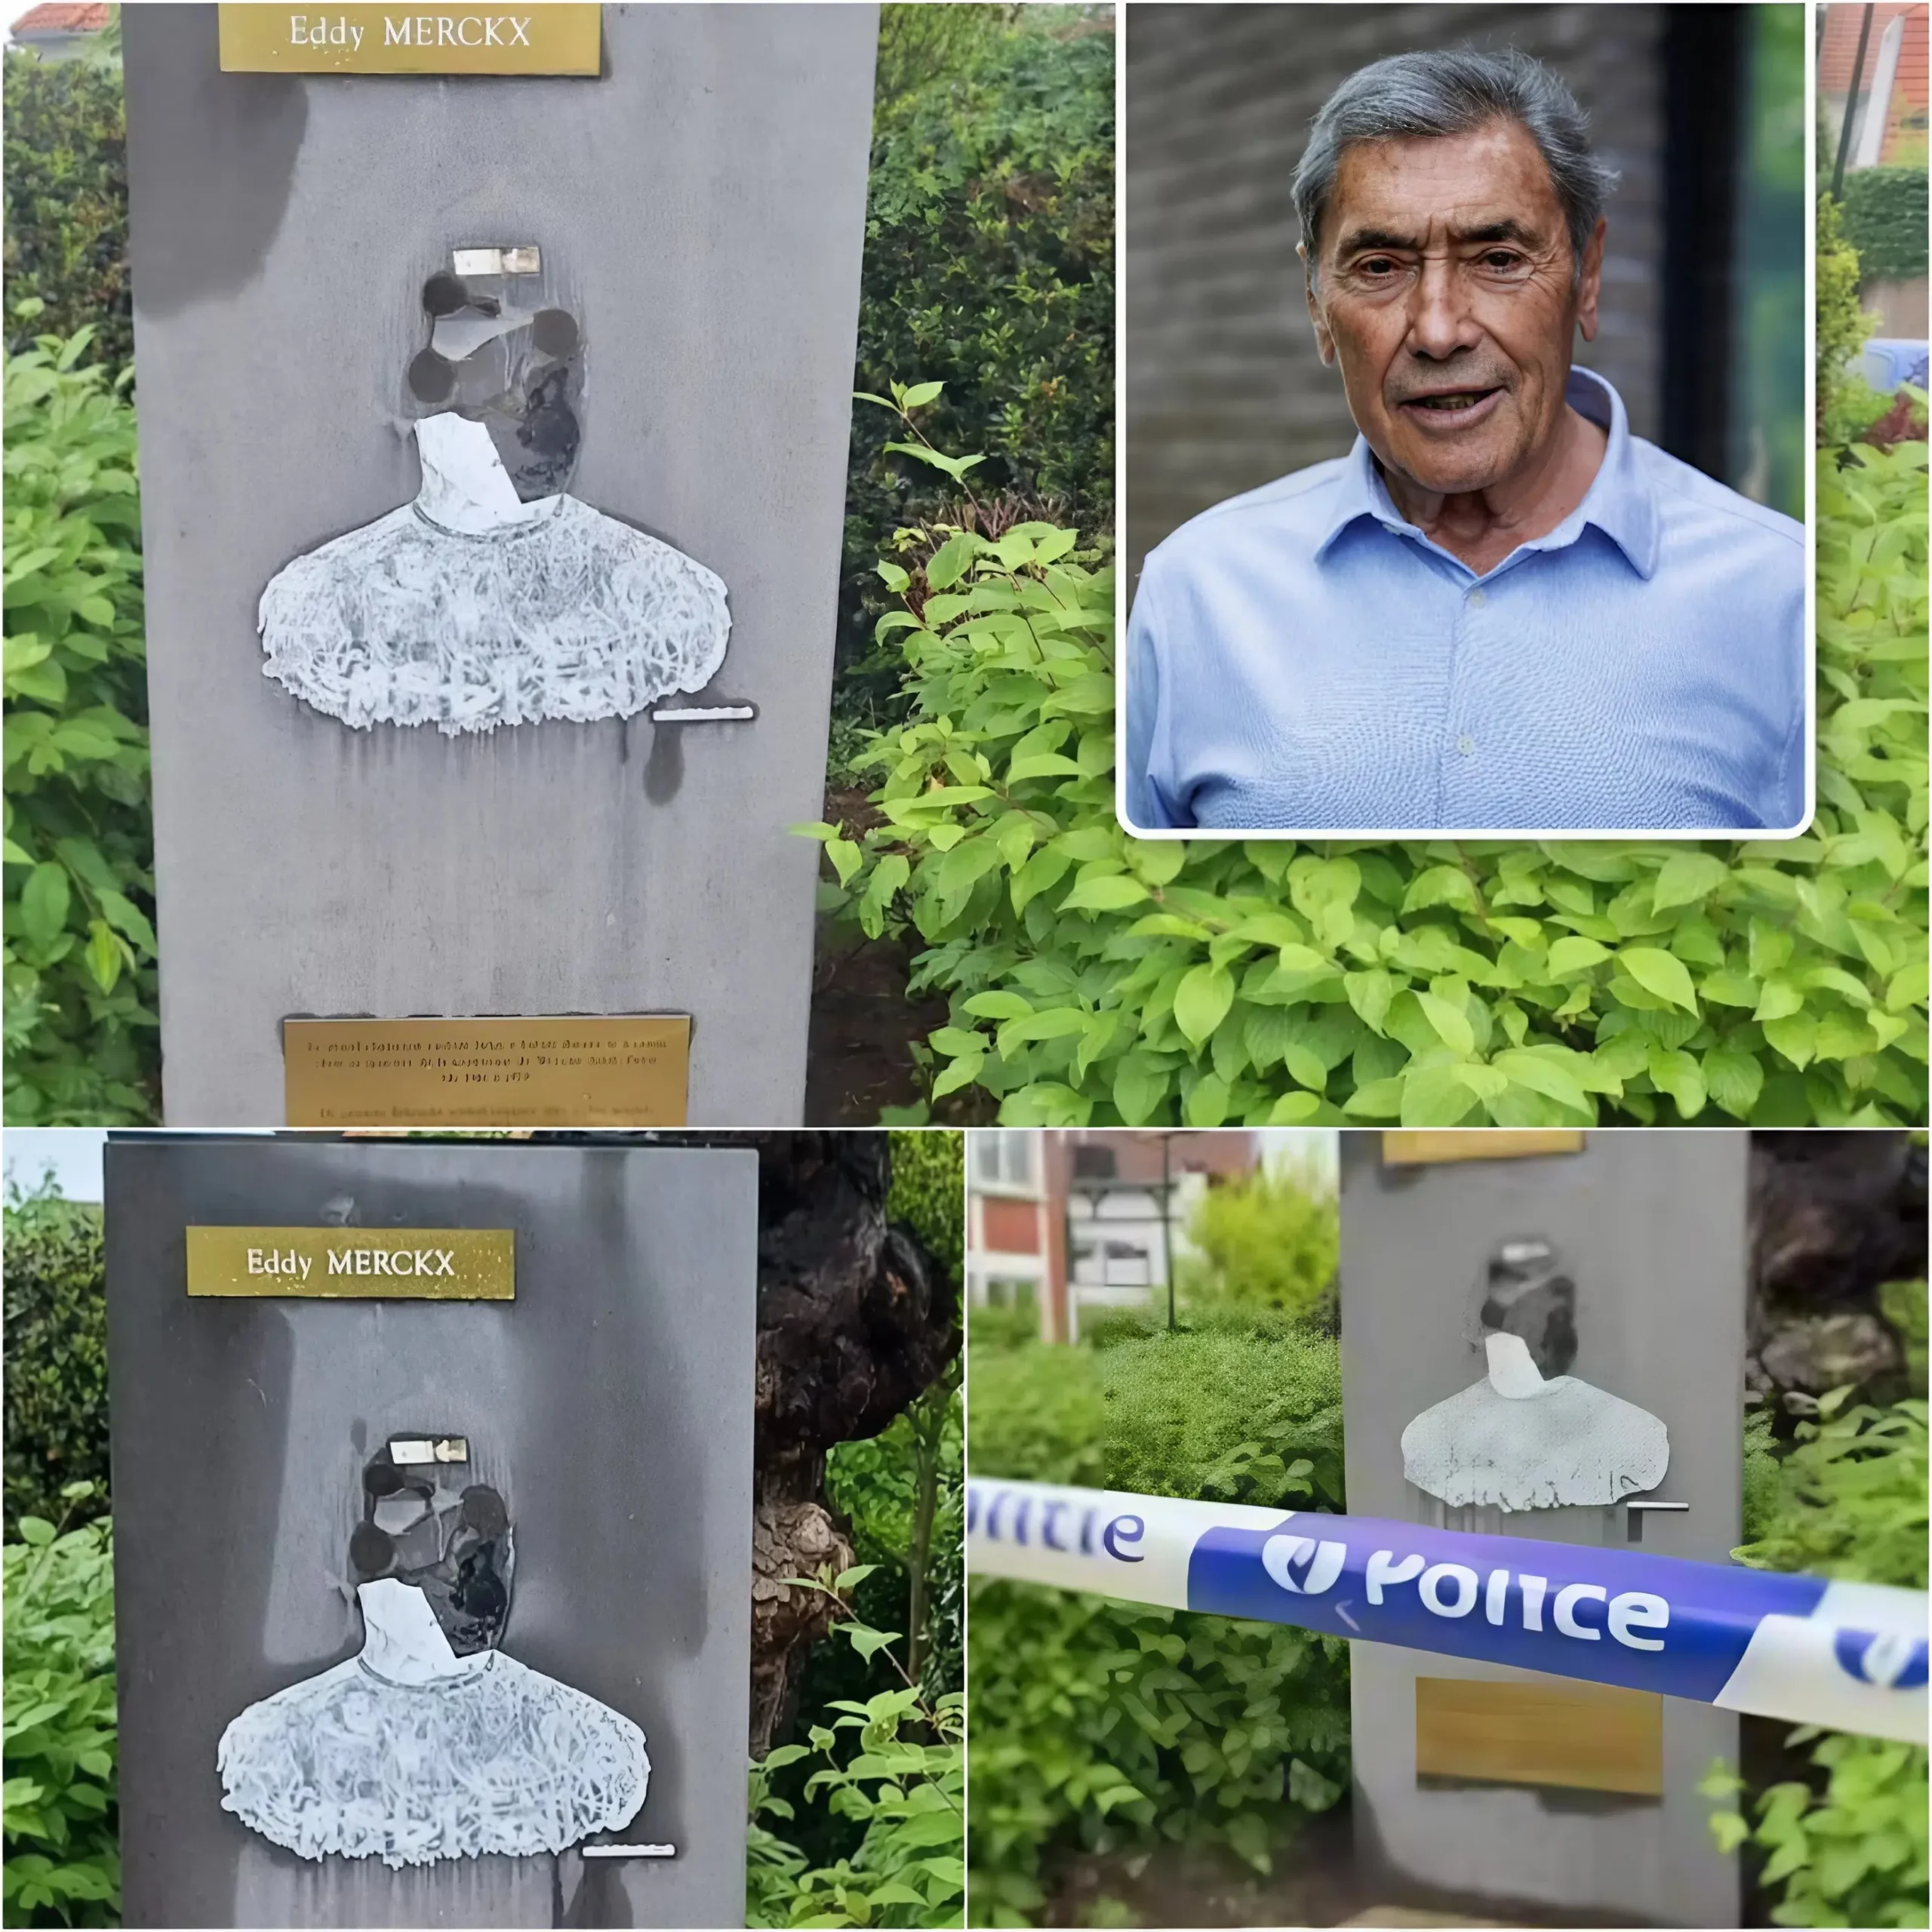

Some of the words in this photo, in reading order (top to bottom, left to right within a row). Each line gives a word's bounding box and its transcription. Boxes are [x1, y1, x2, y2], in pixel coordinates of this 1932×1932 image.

[289, 15, 365, 51] Eddy
[383, 17, 531, 47] MERCKX
[247, 1248, 312, 1281] Eddy
[327, 1248, 455, 1275] MERCKX
